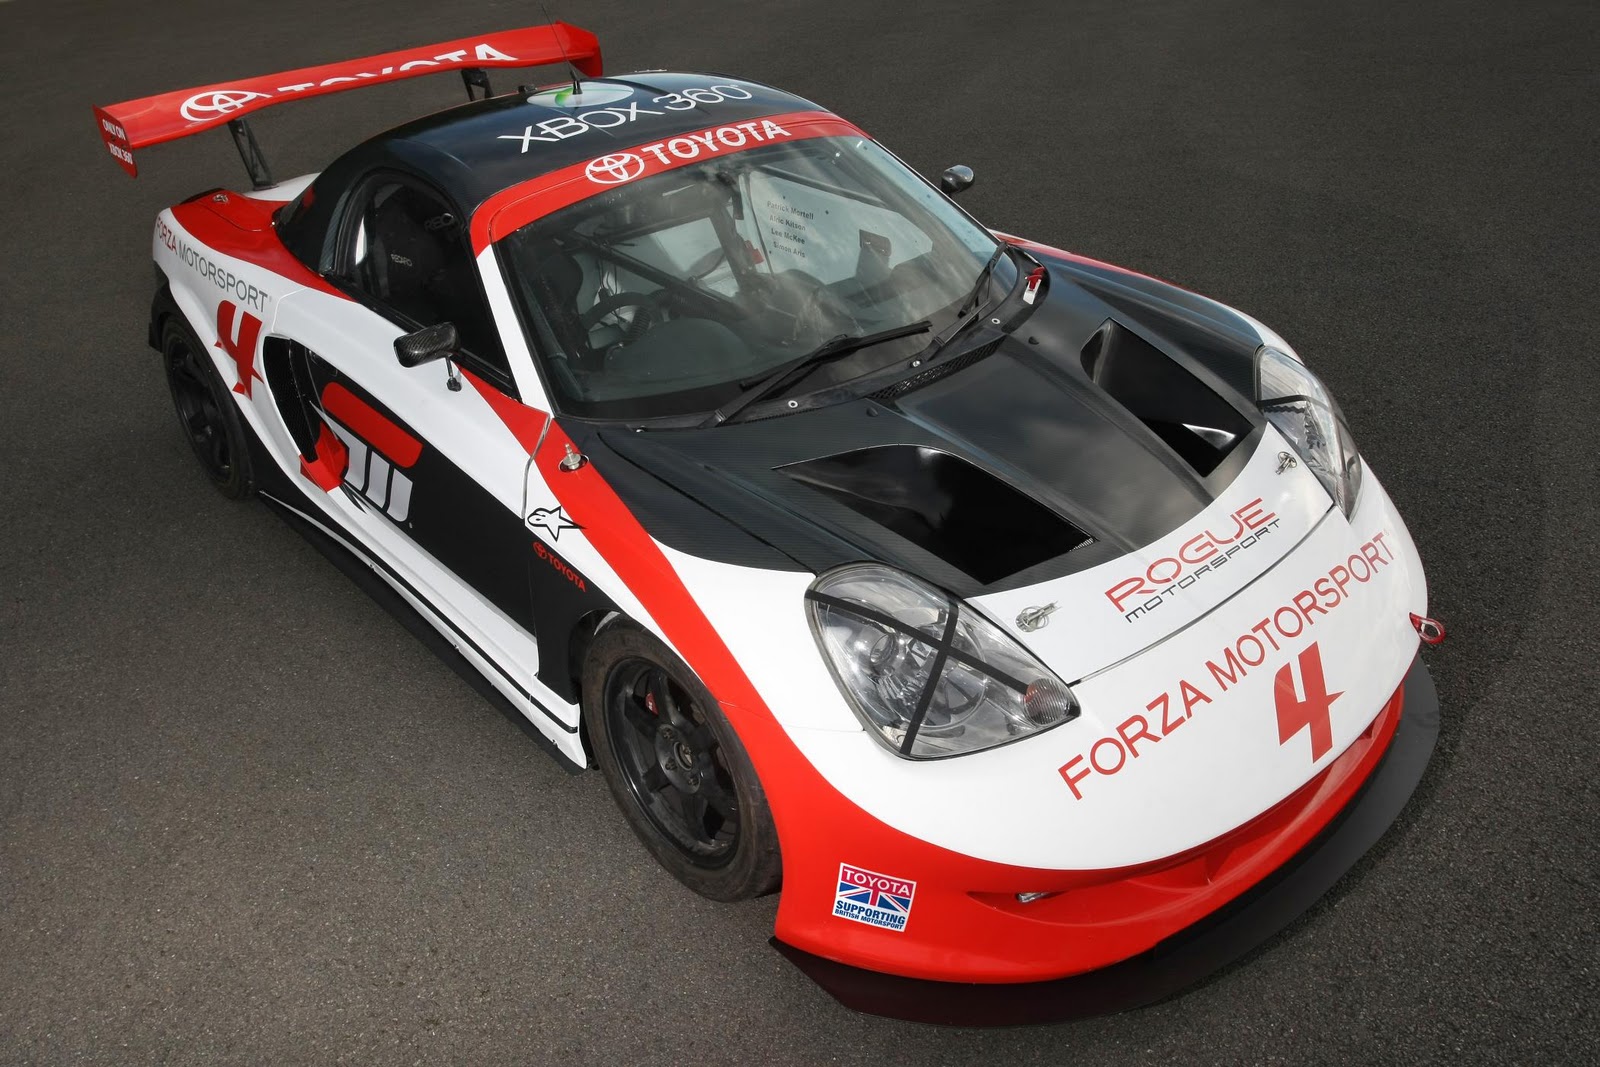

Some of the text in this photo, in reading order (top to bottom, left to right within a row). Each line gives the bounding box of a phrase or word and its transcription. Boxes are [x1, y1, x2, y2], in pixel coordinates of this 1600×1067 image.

[497, 84, 752, 154] XBOX 360
[641, 119, 792, 166] TOYOTA
[178, 240, 268, 313] MOTORSPORT
[214, 300, 265, 401] 4
[547, 552, 586, 593] TOYOTA
[1105, 497, 1277, 613] ROGUE
[1125, 518, 1280, 623] MOTORSPORT
[1058, 532, 1394, 801] FORZA MOTORSPORT
[1273, 641, 1346, 764] 4
[836, 900, 906, 925] SUPPORTING
[844, 868, 910, 896] TOYOTA
[835, 908, 904, 930] BRITISH MOTORSPORT
